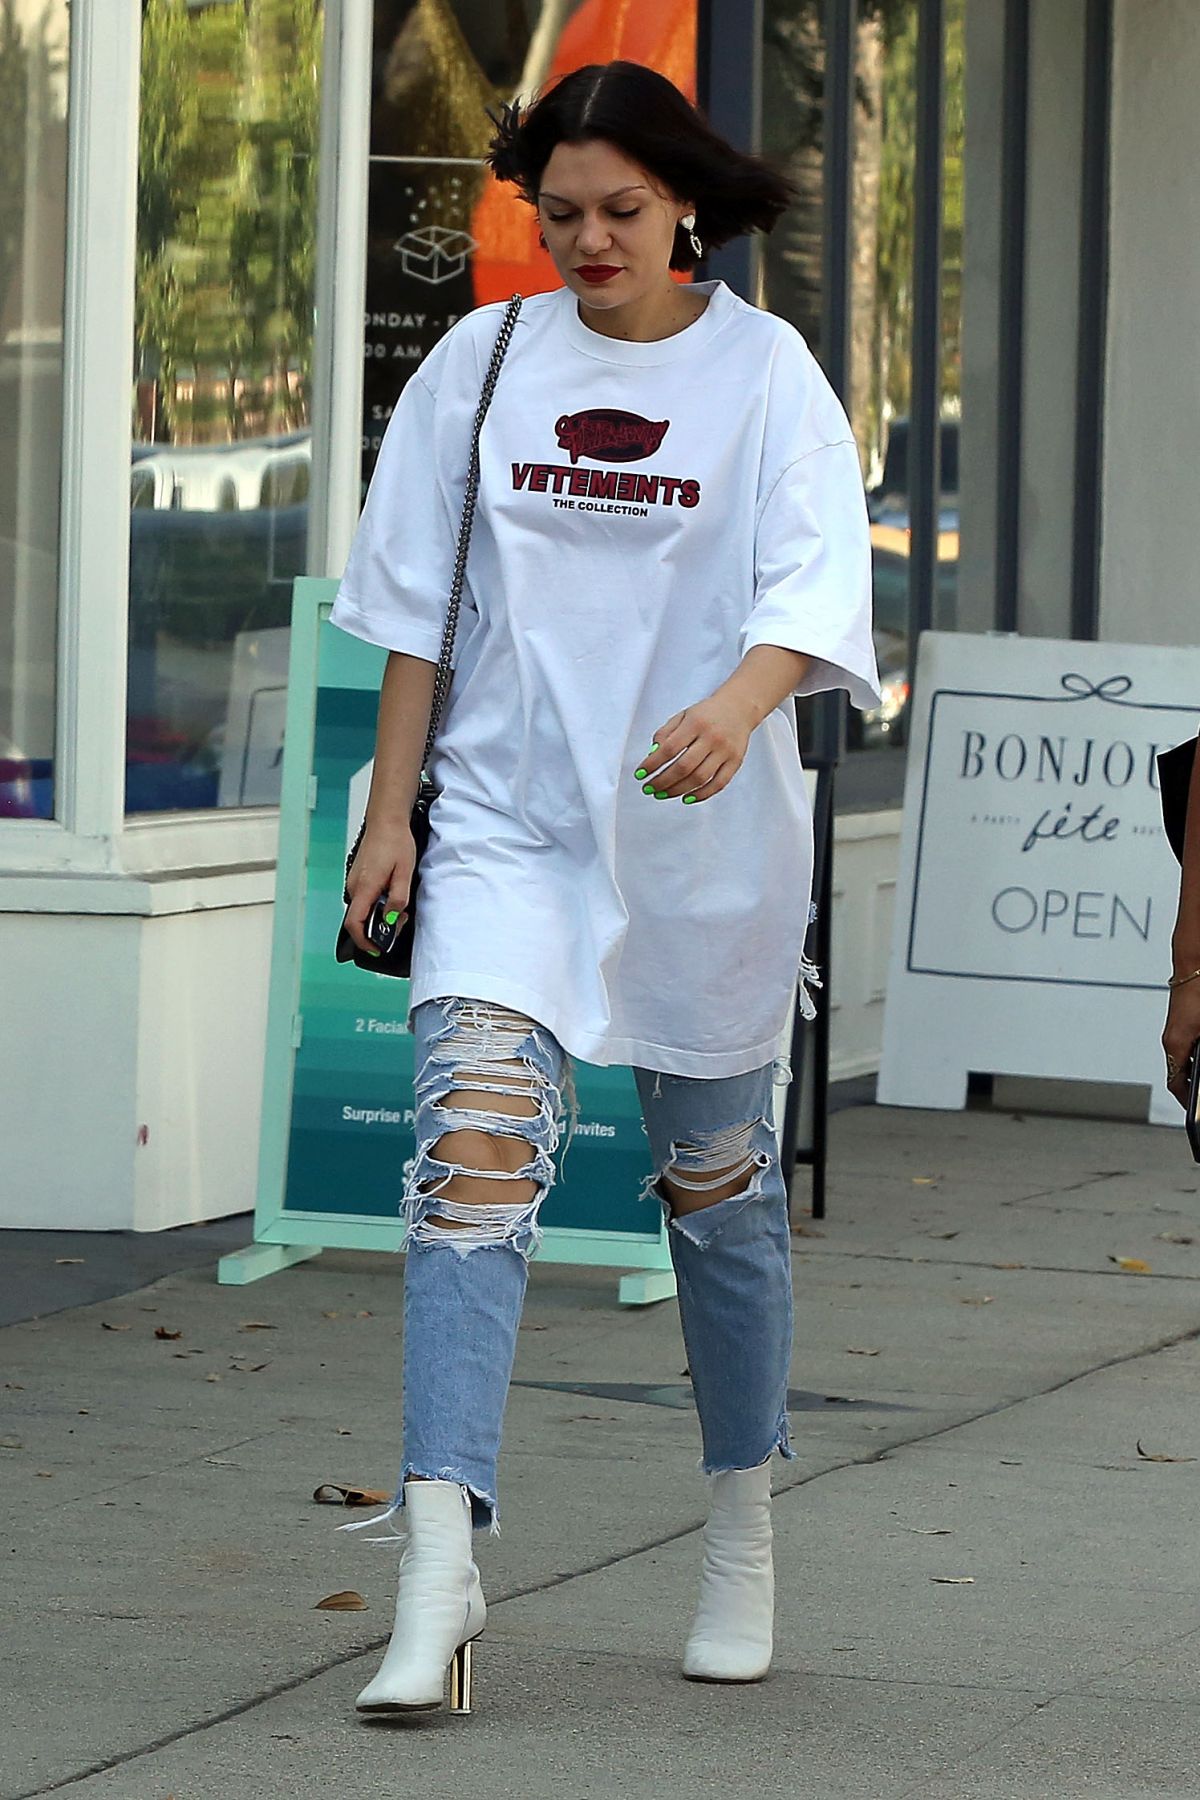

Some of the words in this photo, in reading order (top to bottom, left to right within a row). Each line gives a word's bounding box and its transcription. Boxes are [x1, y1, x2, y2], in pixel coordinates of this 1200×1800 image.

[392, 344, 422, 358] AM
[553, 499, 575, 510] THE
[578, 502, 648, 517] COLLECTION
[992, 886, 1152, 943] OPEN
[355, 1018, 364, 1032] 2
[342, 1106, 401, 1124] Surprise
[403, 1110, 417, 1123] P
[571, 1121, 616, 1137] nvites
